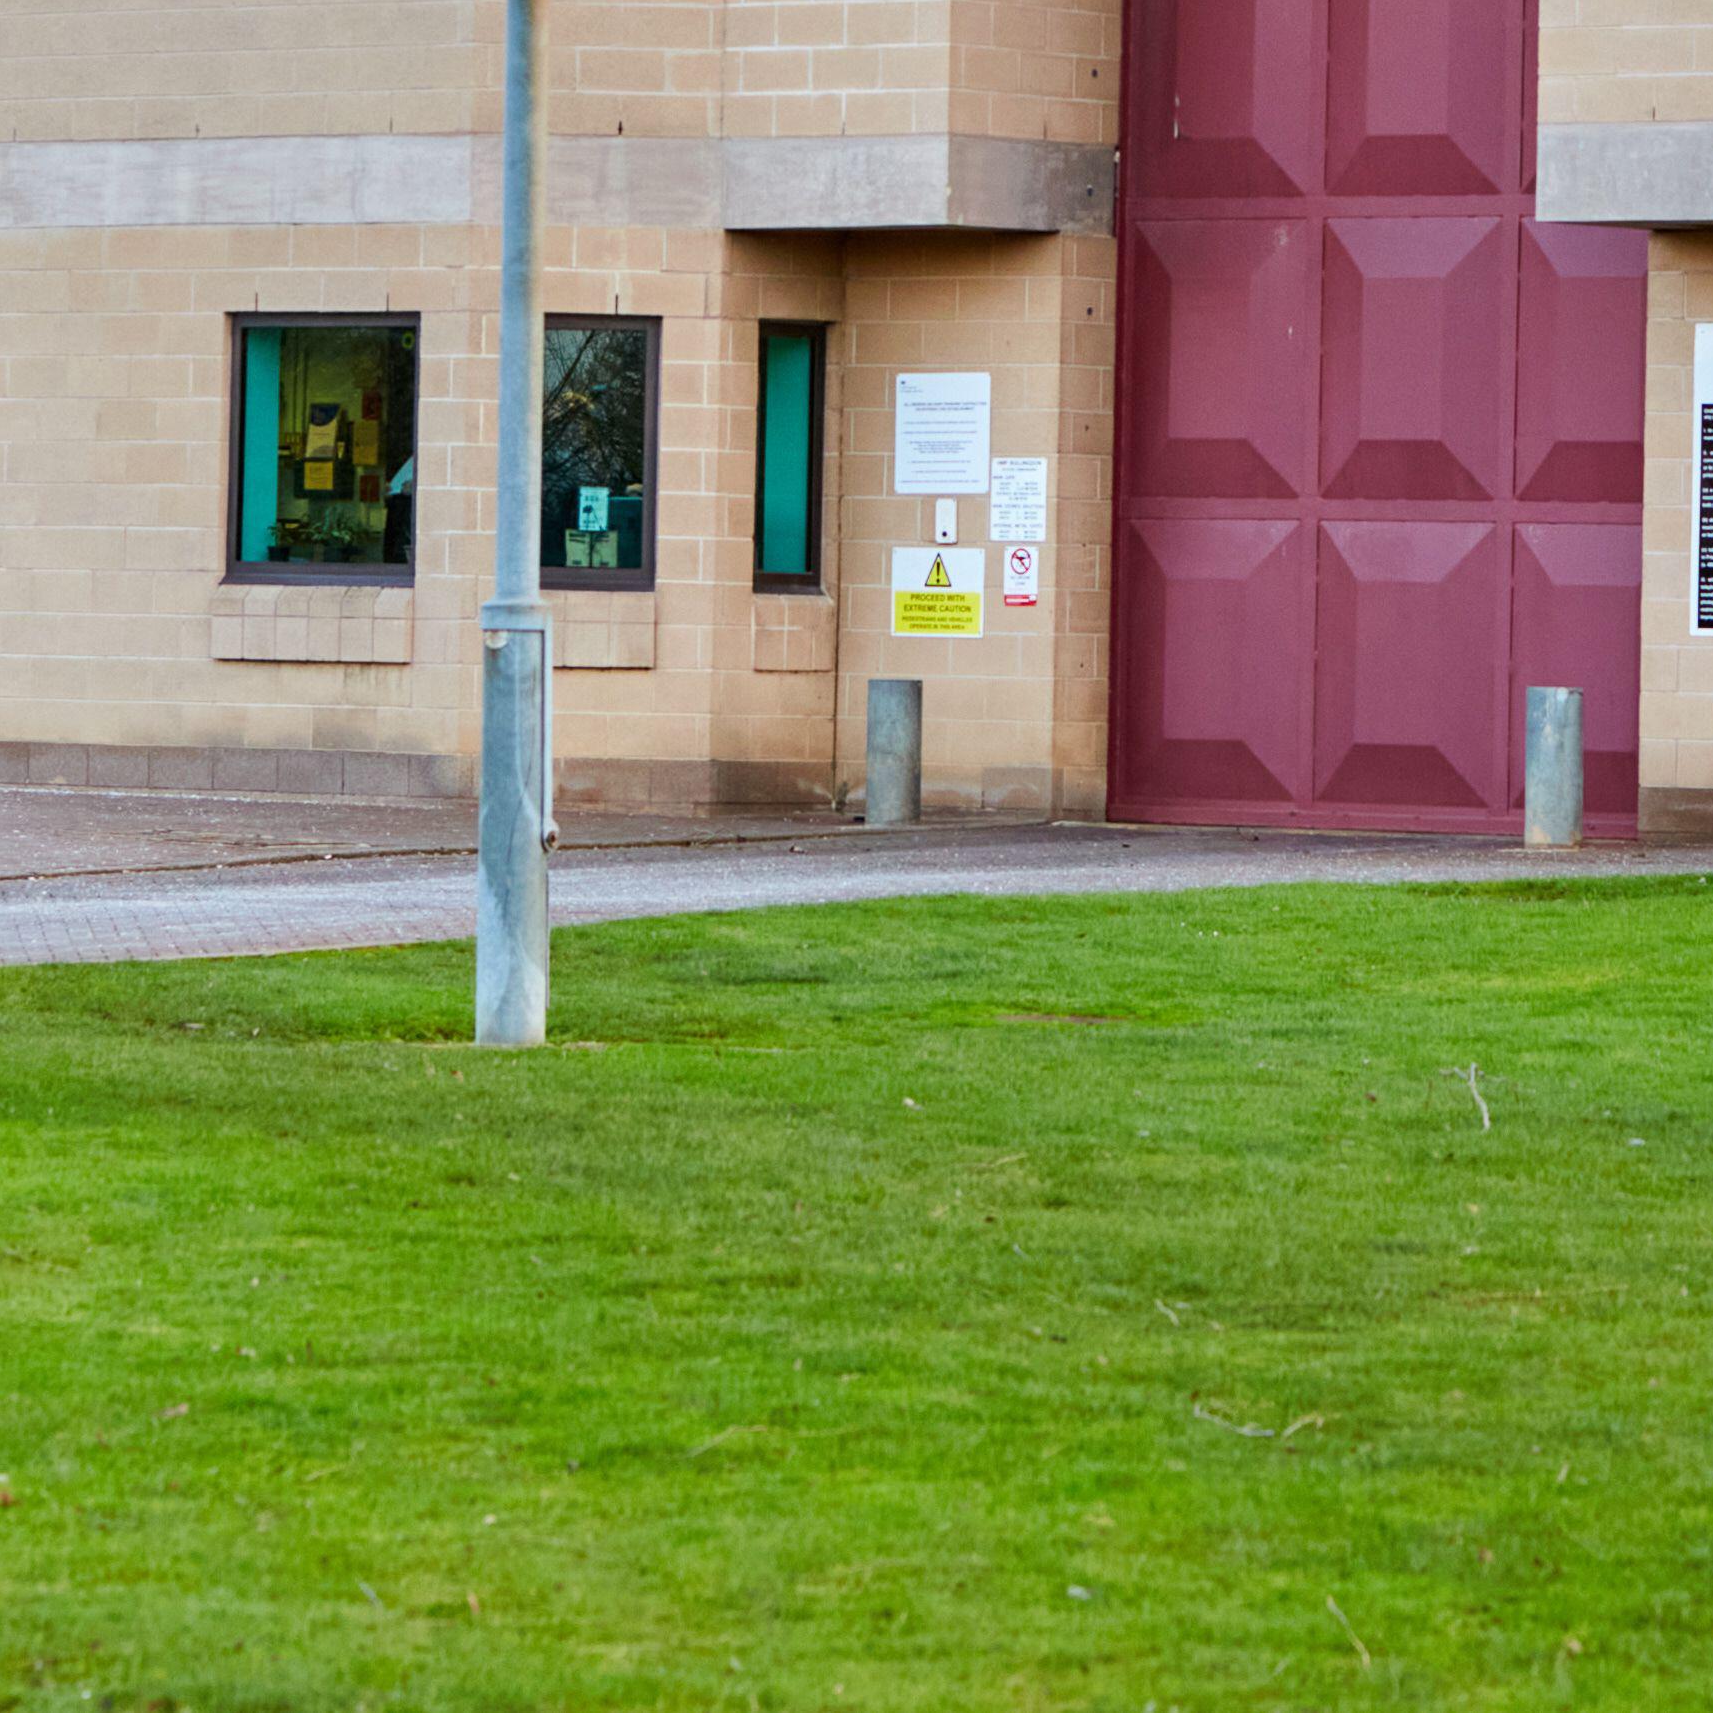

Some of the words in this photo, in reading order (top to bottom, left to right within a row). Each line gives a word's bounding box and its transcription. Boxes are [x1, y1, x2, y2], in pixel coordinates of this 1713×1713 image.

[910, 593, 946, 602] PROCEED
[947, 593, 965, 602] WITH
[903, 604, 938, 613] EXTREME
[939, 604, 971, 613] CAUTION
